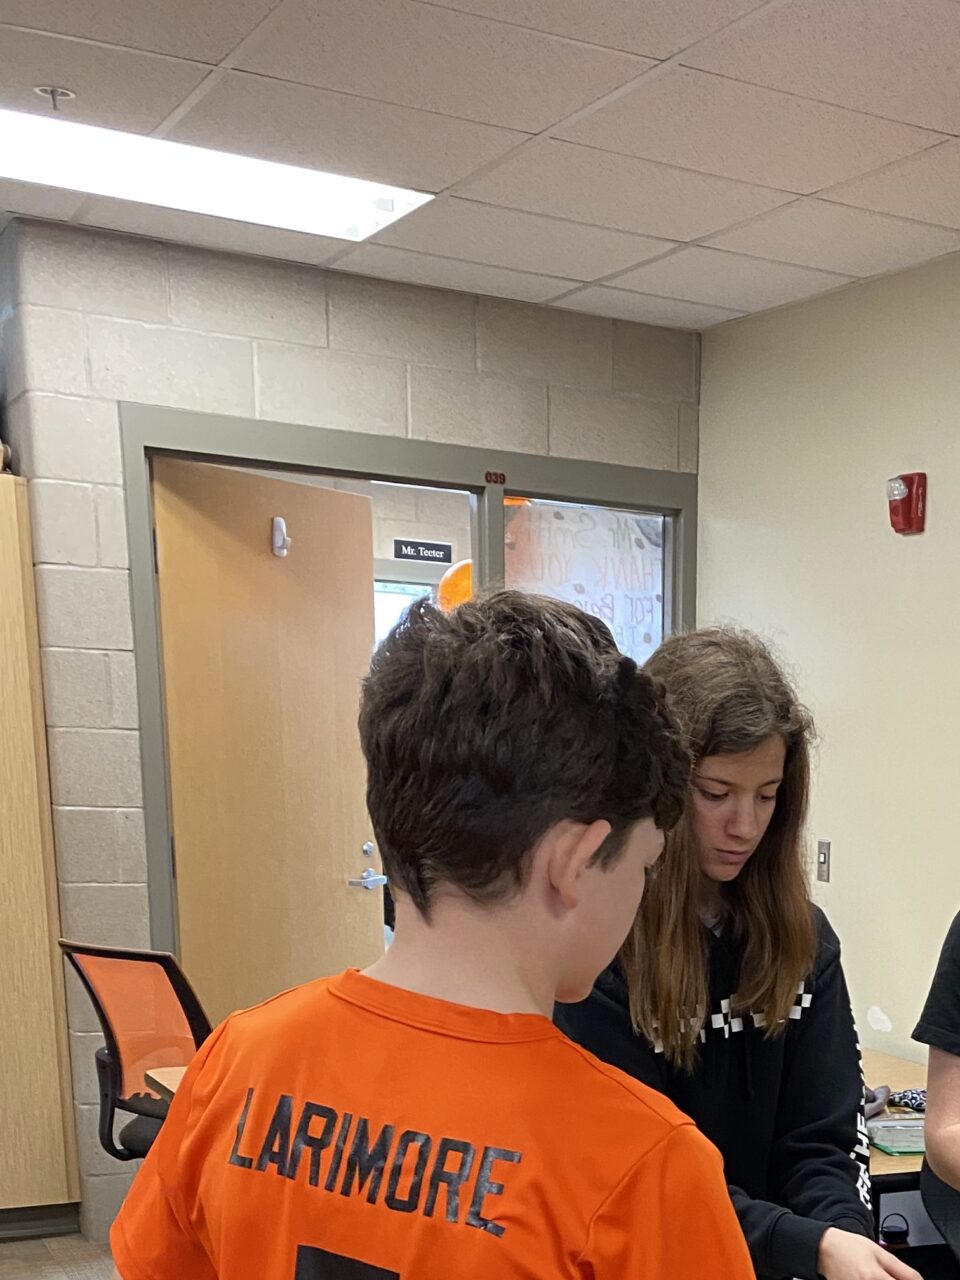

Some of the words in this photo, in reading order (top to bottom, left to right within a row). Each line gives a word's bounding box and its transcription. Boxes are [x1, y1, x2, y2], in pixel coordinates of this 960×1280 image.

[485, 470, 506, 485] 039
[401, 544, 416, 556] Mr.
[229, 1087, 521, 1238] LARIMORE
